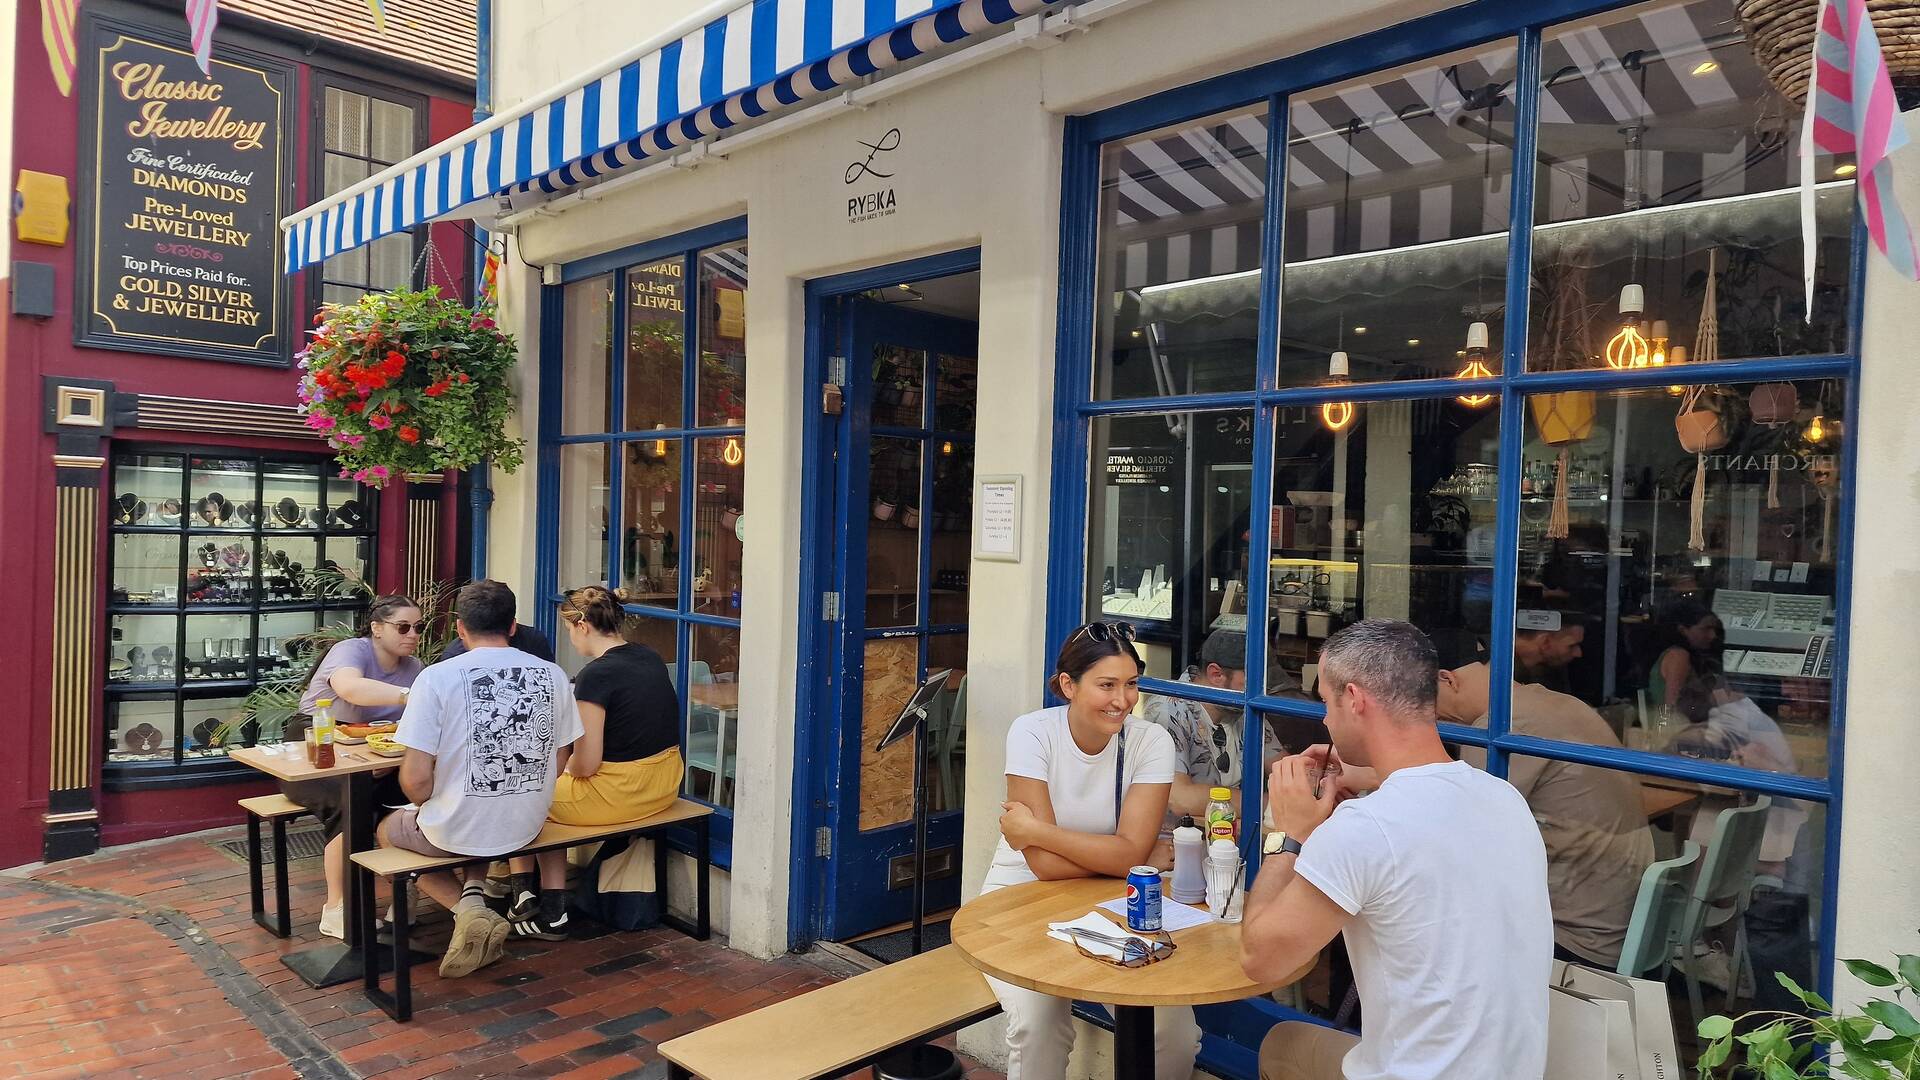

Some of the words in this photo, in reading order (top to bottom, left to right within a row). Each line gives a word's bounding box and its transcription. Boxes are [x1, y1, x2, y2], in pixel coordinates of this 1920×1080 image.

[112, 61, 224, 101] Classic
[127, 101, 266, 150] Jewellery
[127, 148, 165, 169] Fine
[166, 154, 253, 186] Certificated
[132, 167, 248, 204] DIAMONDS
[145, 197, 234, 227] Pre-Loved
[848, 189, 896, 217] RYBKA
[125, 214, 251, 248] JEWELLERY
[121, 255, 148, 273] Top
[151, 259, 193, 278] Prices
[195, 267, 223, 283] Paid
[119, 275, 184, 300] GOLD,
[188, 285, 254, 308] SILVER
[112, 293, 129, 311] &
[136, 297, 261, 327] JEWELLERY
